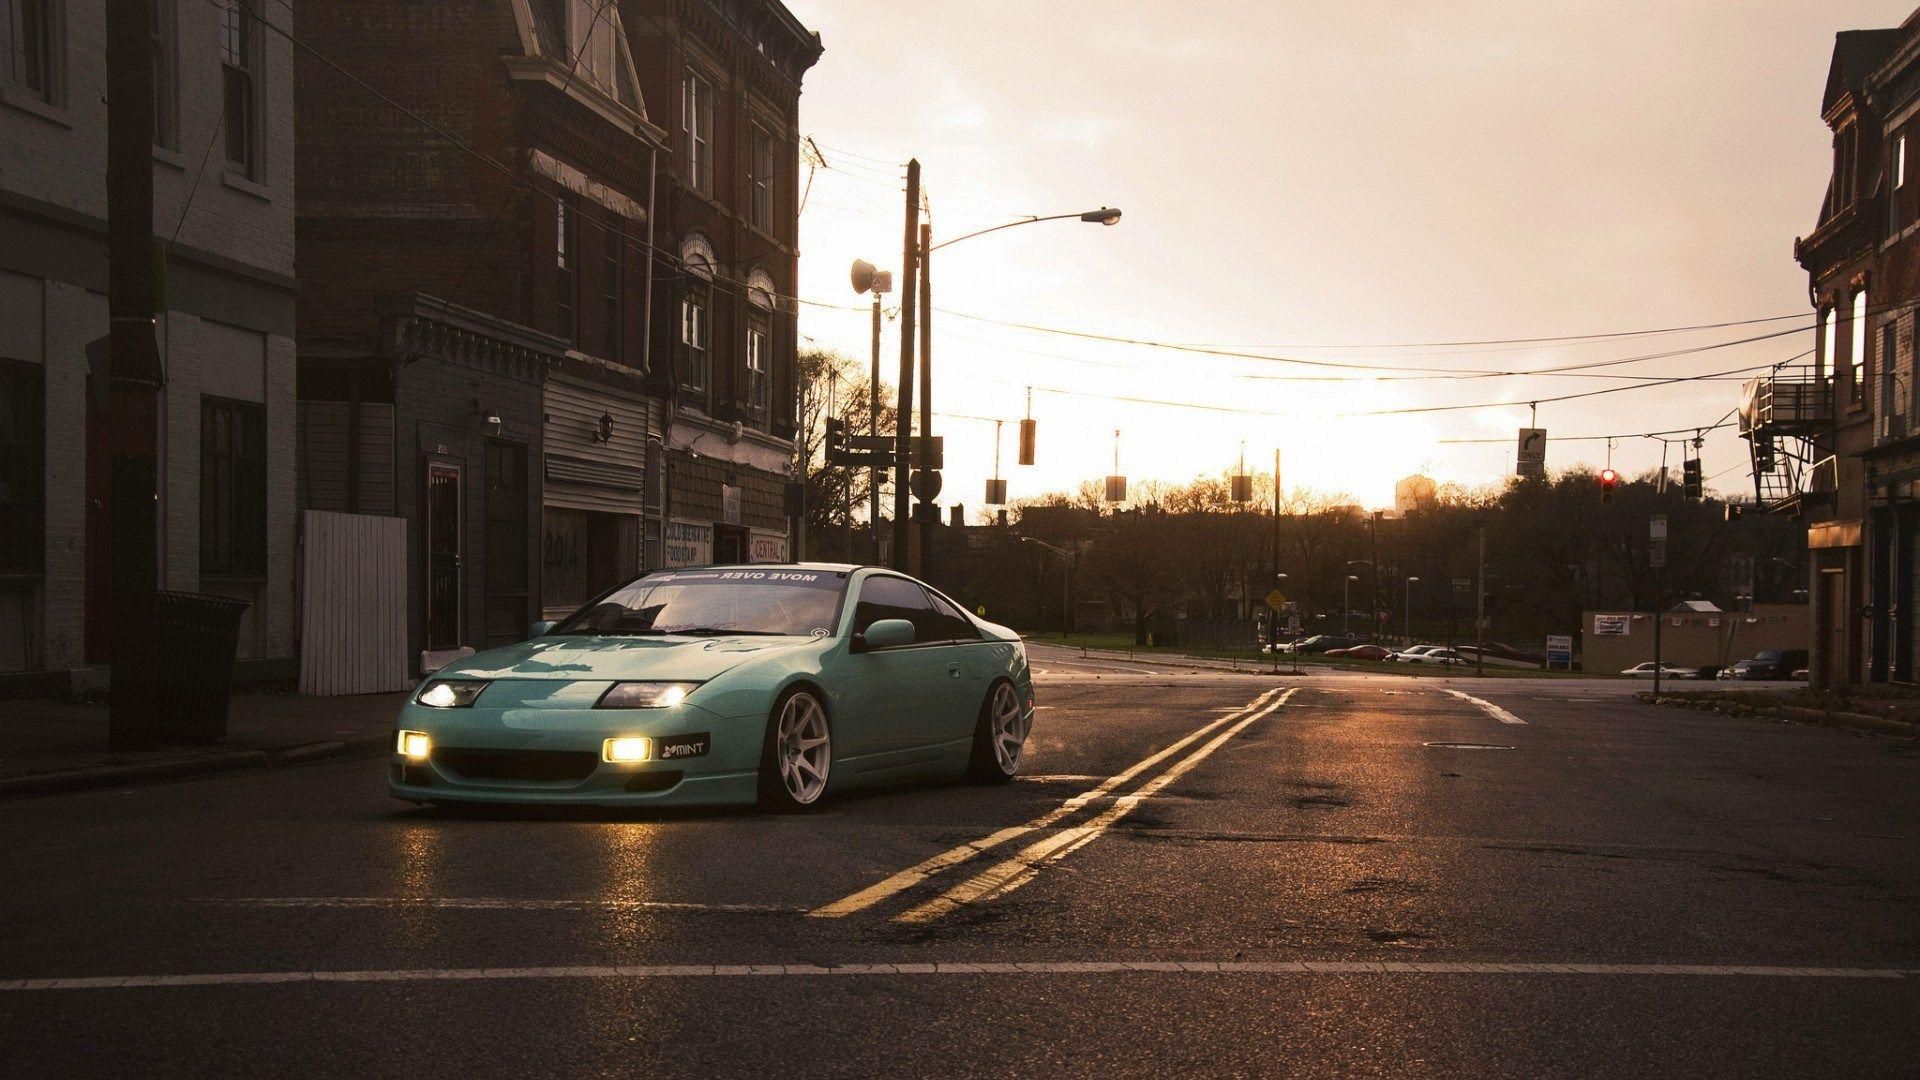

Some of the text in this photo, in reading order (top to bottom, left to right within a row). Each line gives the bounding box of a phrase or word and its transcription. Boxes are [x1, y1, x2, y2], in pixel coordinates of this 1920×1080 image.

[1521, 451, 1542, 459] ONLY
[756, 540, 780, 560] CENTRAL
[676, 742, 704, 756] MINT
